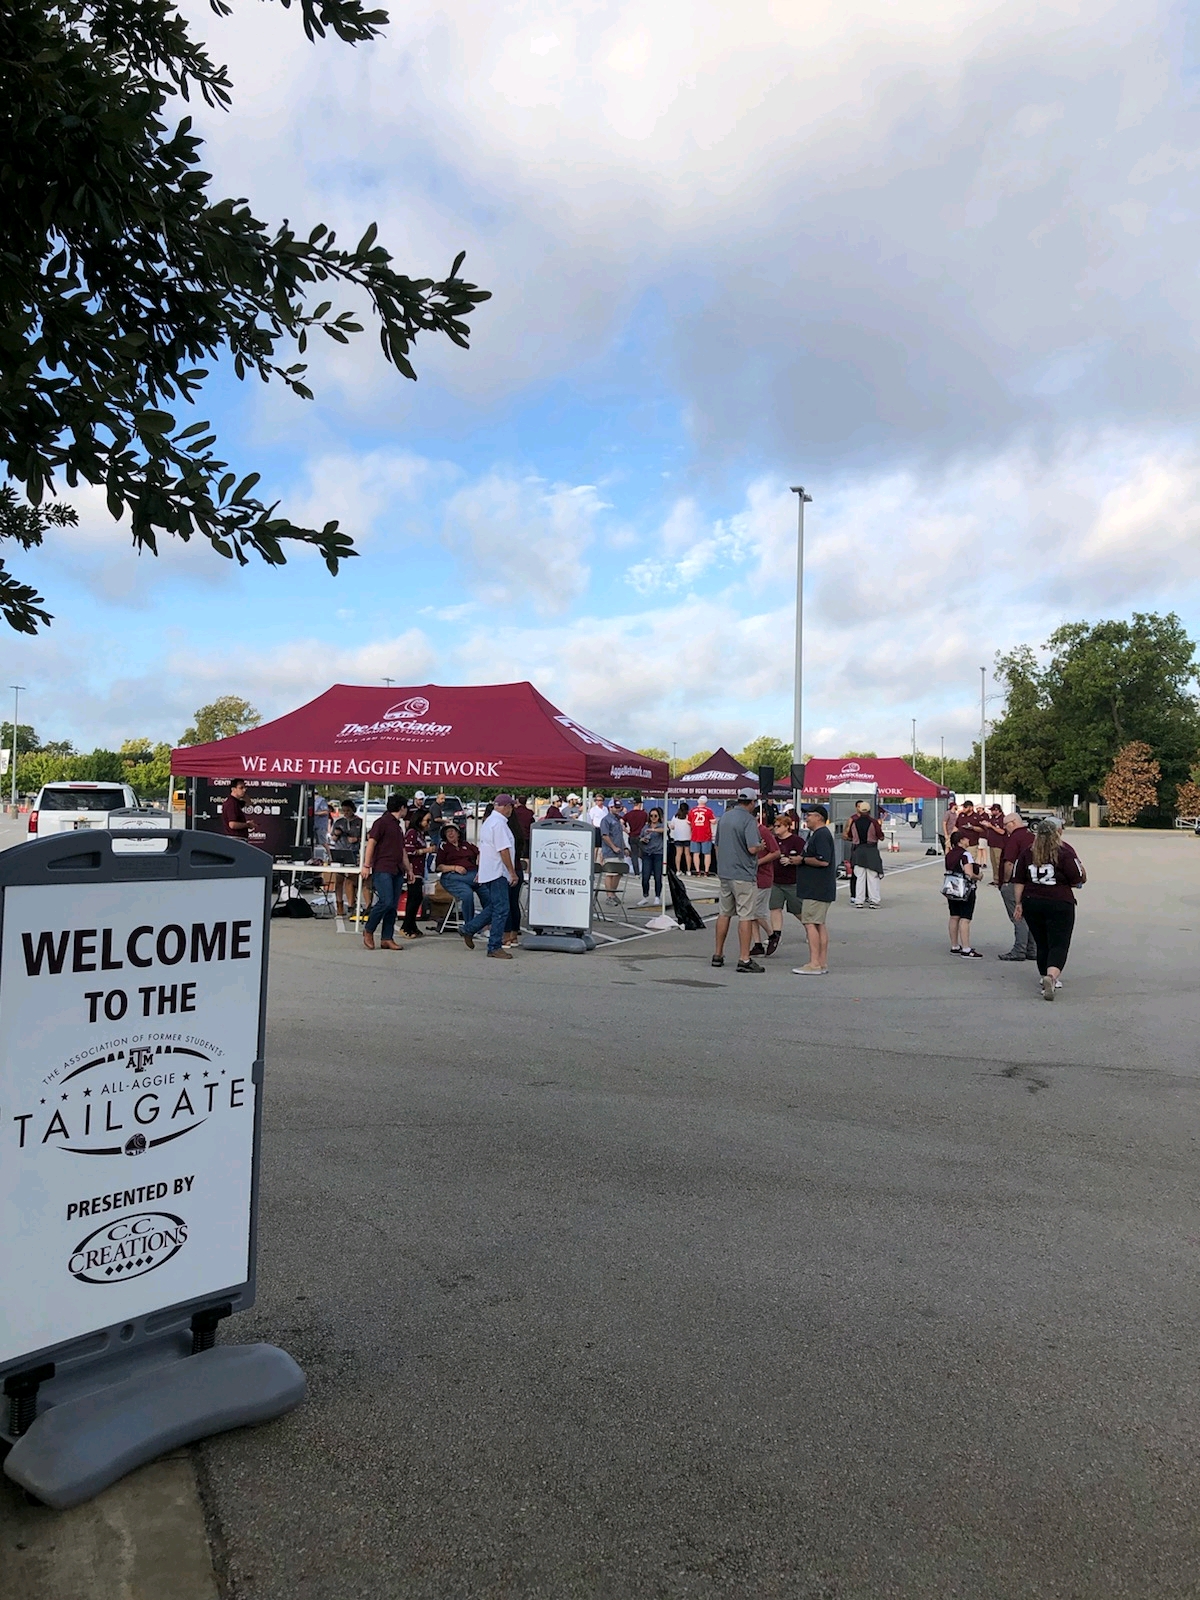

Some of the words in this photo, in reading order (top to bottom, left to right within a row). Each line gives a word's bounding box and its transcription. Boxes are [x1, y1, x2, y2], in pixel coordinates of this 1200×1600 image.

[368, 719, 453, 733] Association
[241, 756, 267, 772] WE
[271, 758, 303, 773] ARE
[308, 759, 341, 774] THE
[345, 760, 400, 775] AGGIE
[406, 759, 500, 777] NETWORK
[610, 764, 652, 779] AggieNetwork.com
[694, 812, 706, 823] 25
[535, 850, 589, 861] TAILGATE
[534, 876, 587, 887] PRE-REGISTERED
[1028, 863, 1056, 886] 12
[545, 887, 575, 896] CHECK-IN
[21, 920, 252, 977] WELCOME
[84, 989, 128, 1023] TO
[138, 982, 197, 1017] THE
[42, 1068, 60, 1085] THE
[64, 1037, 128, 1069] ASSOCIATION
[132, 1034, 144, 1043] OF
[148, 1033, 182, 1041] FORMER
[101, 1073, 176, 1095] ALL-AGGIE
[13, 1078, 245, 1148] TAILGATE
[66, 1182, 168, 1221] PRESENTED
[173, 1175, 195, 1194] BY
[107, 1218, 155, 1241] C.C.
[68, 1225, 188, 1274] CREATIONS
